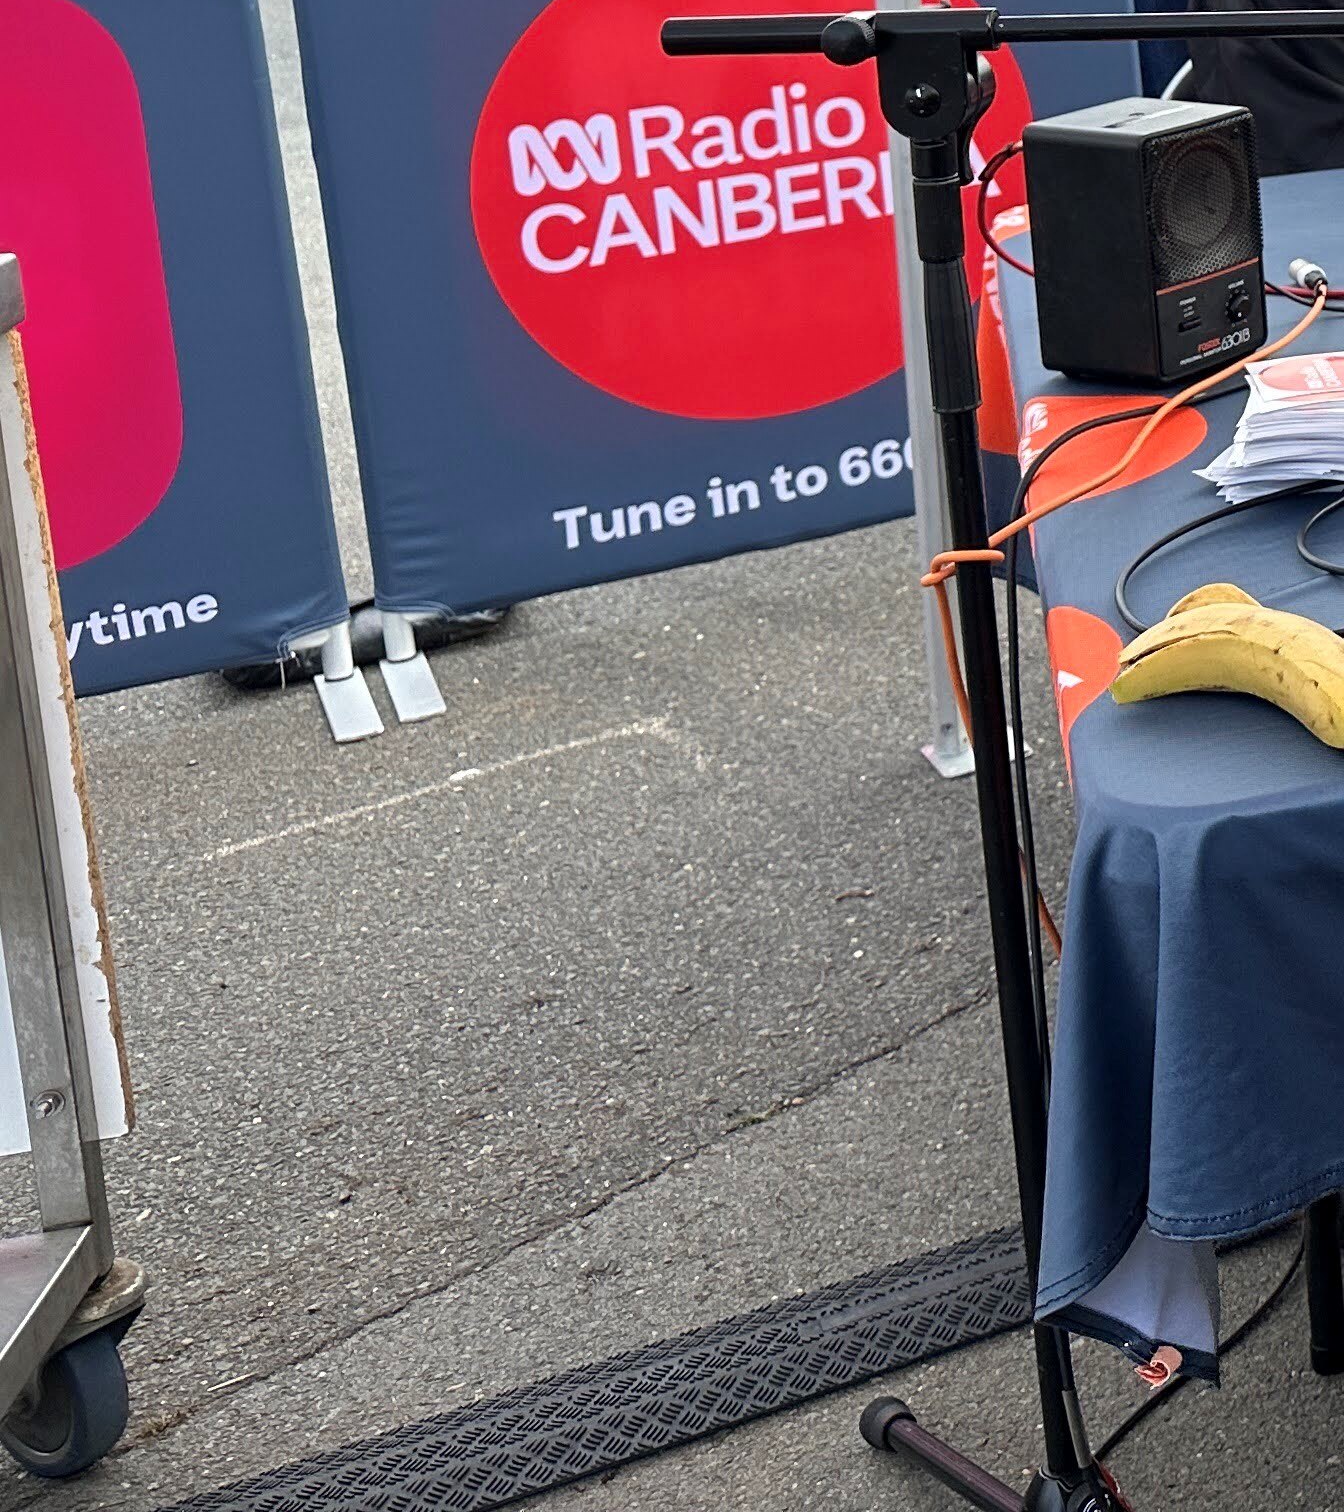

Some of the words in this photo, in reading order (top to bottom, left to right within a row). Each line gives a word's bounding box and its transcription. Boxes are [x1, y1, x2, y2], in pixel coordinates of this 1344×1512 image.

[628, 82, 866, 179] Radio
[520, 143, 1002, 275] CANBER
[554, 495, 695, 550] Tune
[708, 476, 760, 518] in
[770, 463, 828, 500] to
[62, 591, 220, 663] ytime
